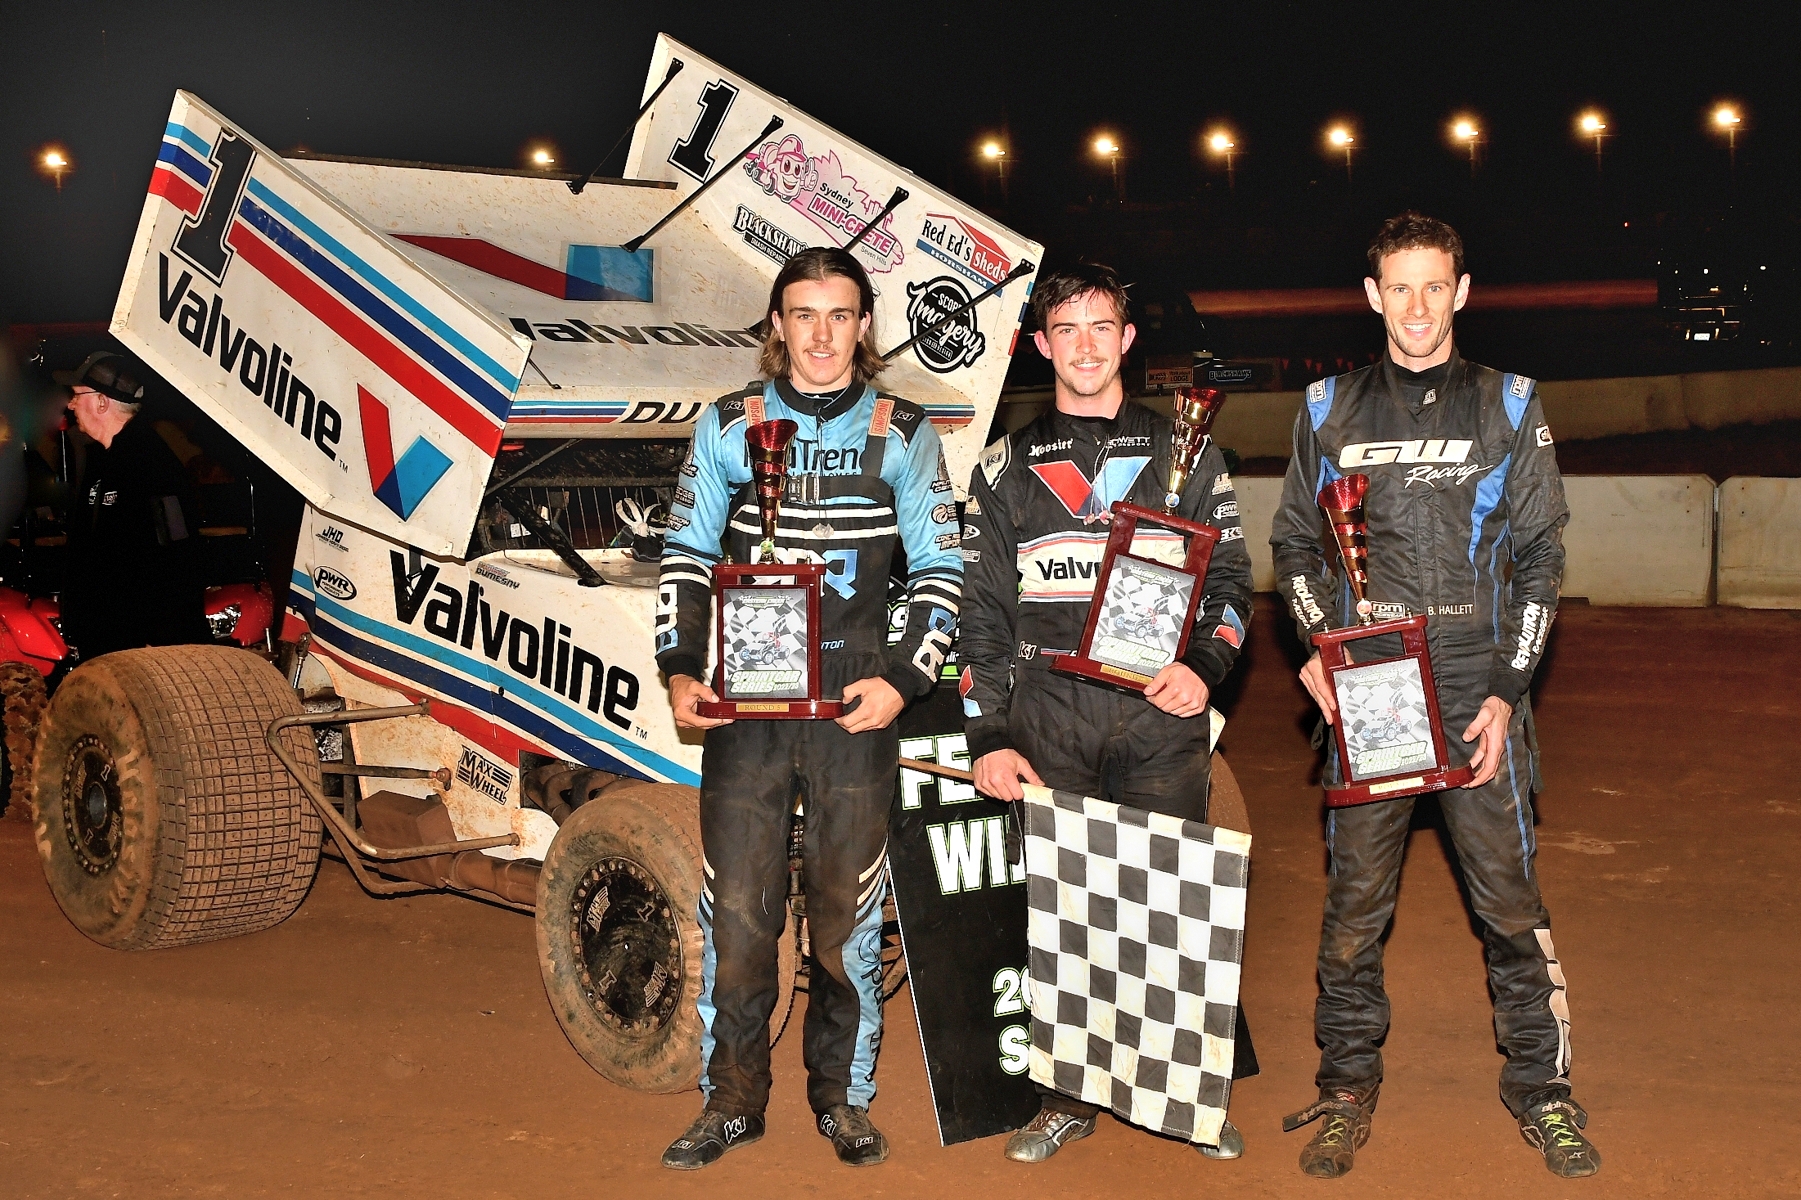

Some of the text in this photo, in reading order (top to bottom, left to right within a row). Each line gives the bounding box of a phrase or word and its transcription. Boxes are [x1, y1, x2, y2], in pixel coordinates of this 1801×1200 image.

[667, 79, 740, 184] 1
[170, 128, 258, 287] 1
[820, 183, 854, 209] Sydney
[750, 237, 787, 264] SMASH REPAIRS
[921, 219, 947, 246] Red
[946, 233, 972, 262] Ed's
[860, 245, 888, 266] Seven Hills
[930, 249, 988, 288] HORSHAM
[158, 251, 342, 461] Valvoline
[751, 398, 761, 425] MPSON
[873, 402, 890, 433] SIMPSON
[1028, 438, 1074, 457] Hoosier
[1338, 440, 1474, 469] GW
[1404, 463, 1494, 489] Racing
[322, 525, 344, 543] JHD
[316, 567, 351, 592] PWR
[1291, 574, 1325, 626] REVOLUTION
[1372, 603, 1403, 613] rpm
[1427, 604, 1474, 616] B. HALLETT
[389, 549, 640, 731] Valvoline
[1510, 600, 1541, 672] REVOLUTION
[731, 670, 802, 682] SPRINTCAR
[731, 681, 776, 693] SERIES
[461, 750, 493, 778] MAX
[899, 733, 985, 811] FE
[470, 772, 504, 803] WHEEL
